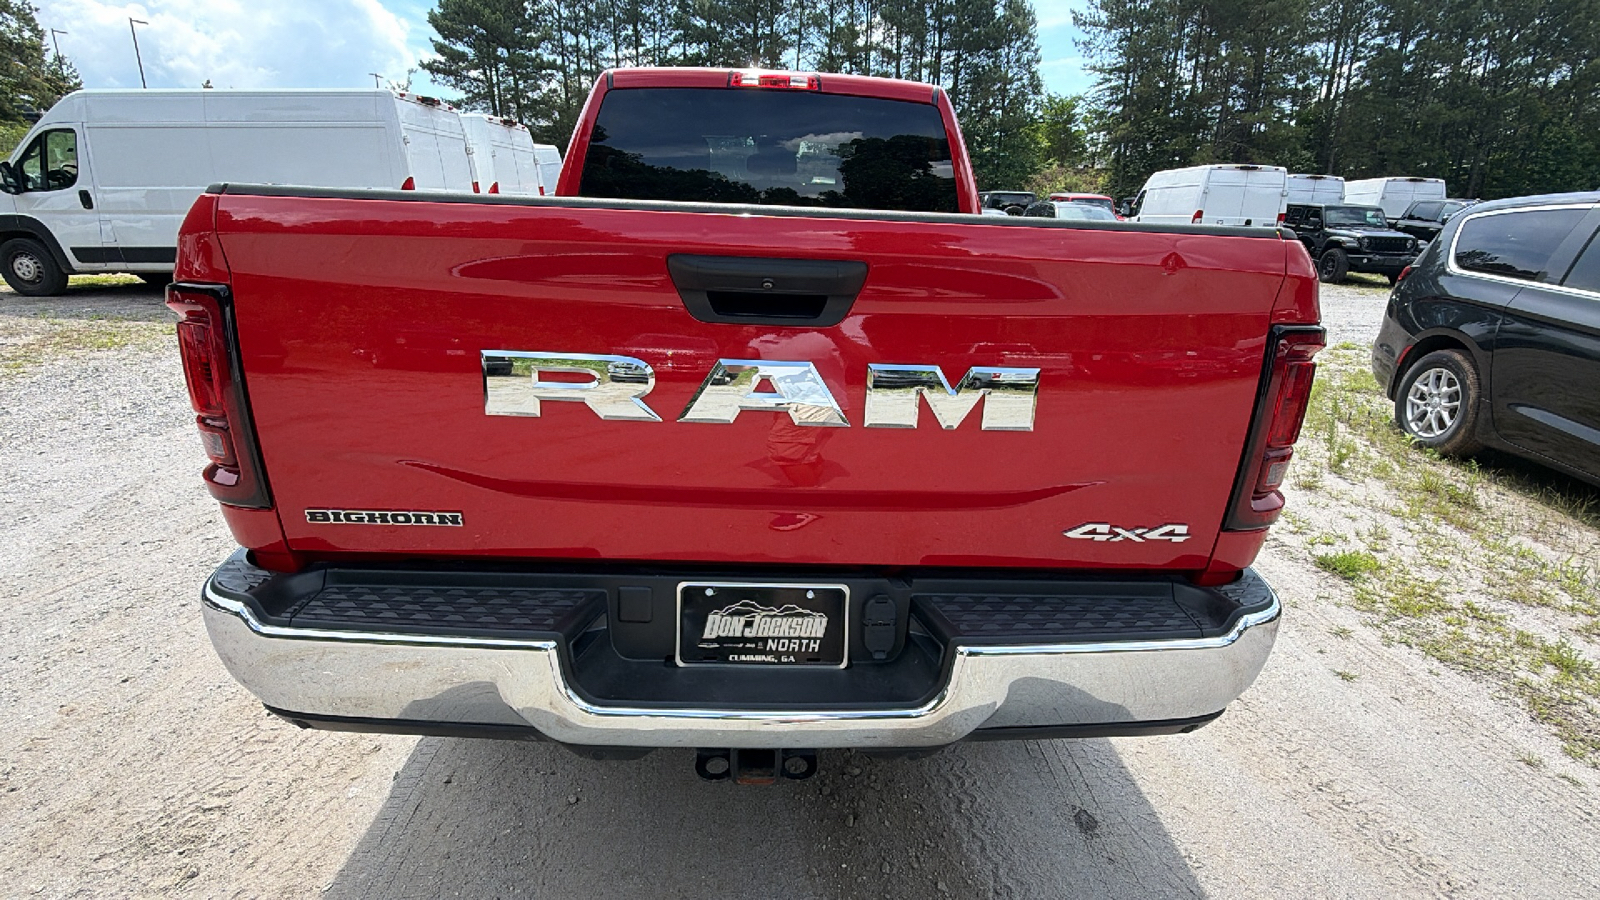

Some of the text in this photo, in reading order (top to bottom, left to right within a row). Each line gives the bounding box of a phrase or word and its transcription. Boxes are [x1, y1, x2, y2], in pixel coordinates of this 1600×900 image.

[480, 349, 1042, 432] RAM
[304, 508, 464, 527] BIGHORN
[702, 614, 828, 638] DON JACKSON
[766, 639, 820, 653] NORTH
[729, 654, 795, 663] CUMMING, GA
